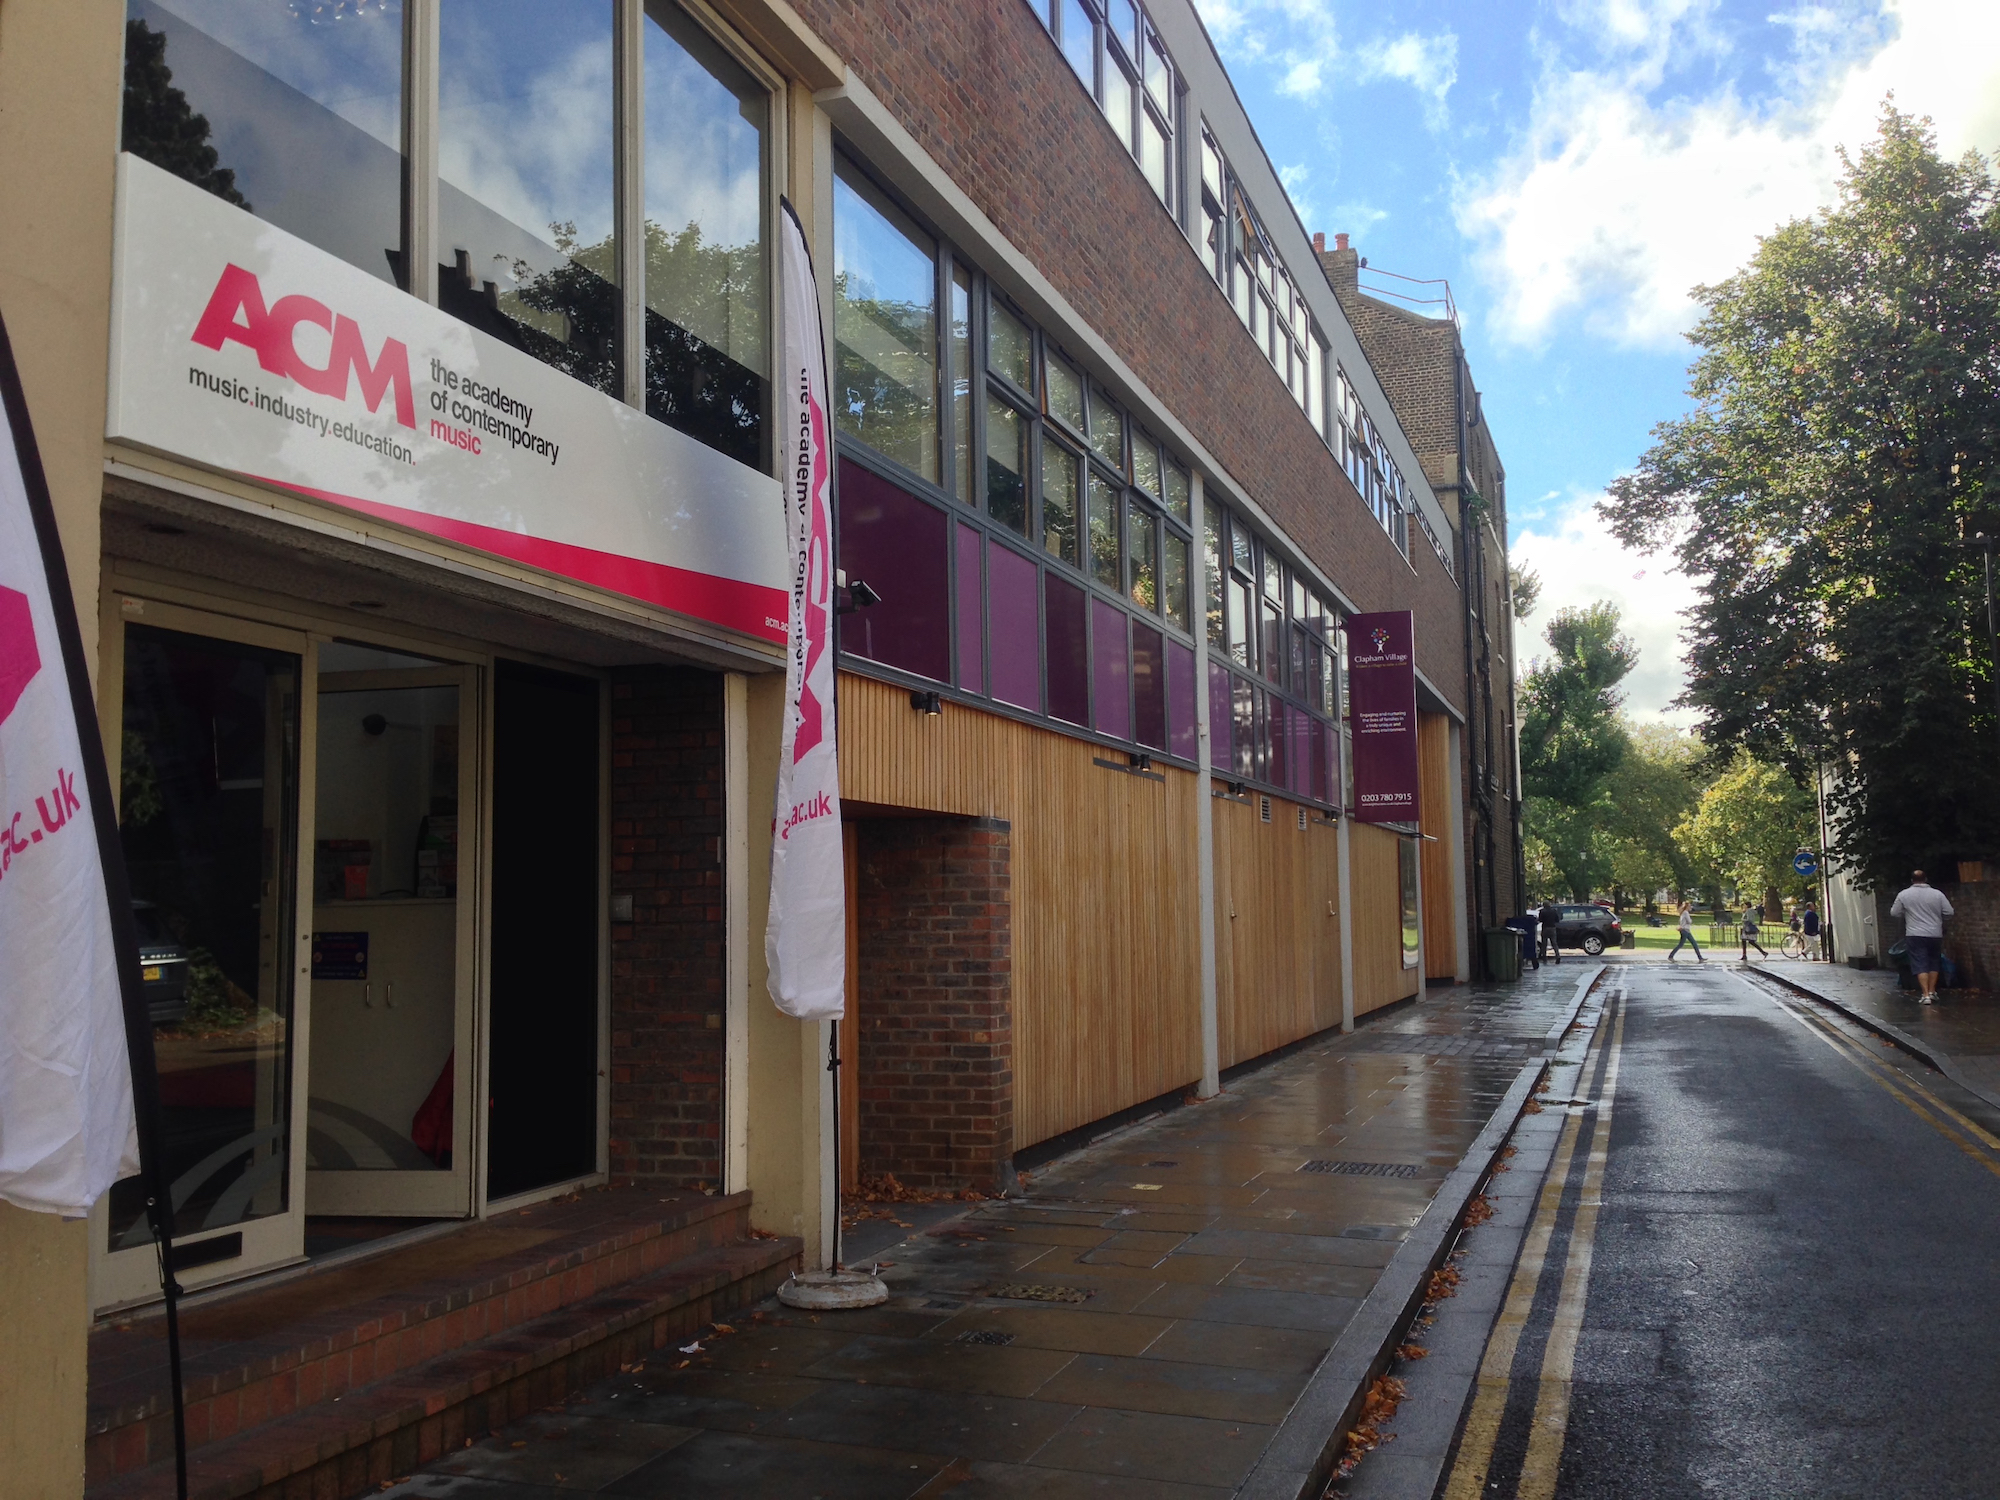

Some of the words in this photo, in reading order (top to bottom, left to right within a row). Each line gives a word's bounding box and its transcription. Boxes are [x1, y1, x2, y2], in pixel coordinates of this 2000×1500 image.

[190, 262, 416, 430] ACM
[430, 358, 458, 390] the
[461, 377, 533, 429] academy
[430, 390, 448, 413] of
[452, 400, 559, 466] contemporary
[430, 418, 482, 455] music
[1354, 655, 1384, 664] Clapham
[1384, 653, 1408, 662] Village
[1361, 794, 1379, 802] 0203
[1380, 793, 1394, 801] 780
[1394, 792, 1412, 801] 7915
